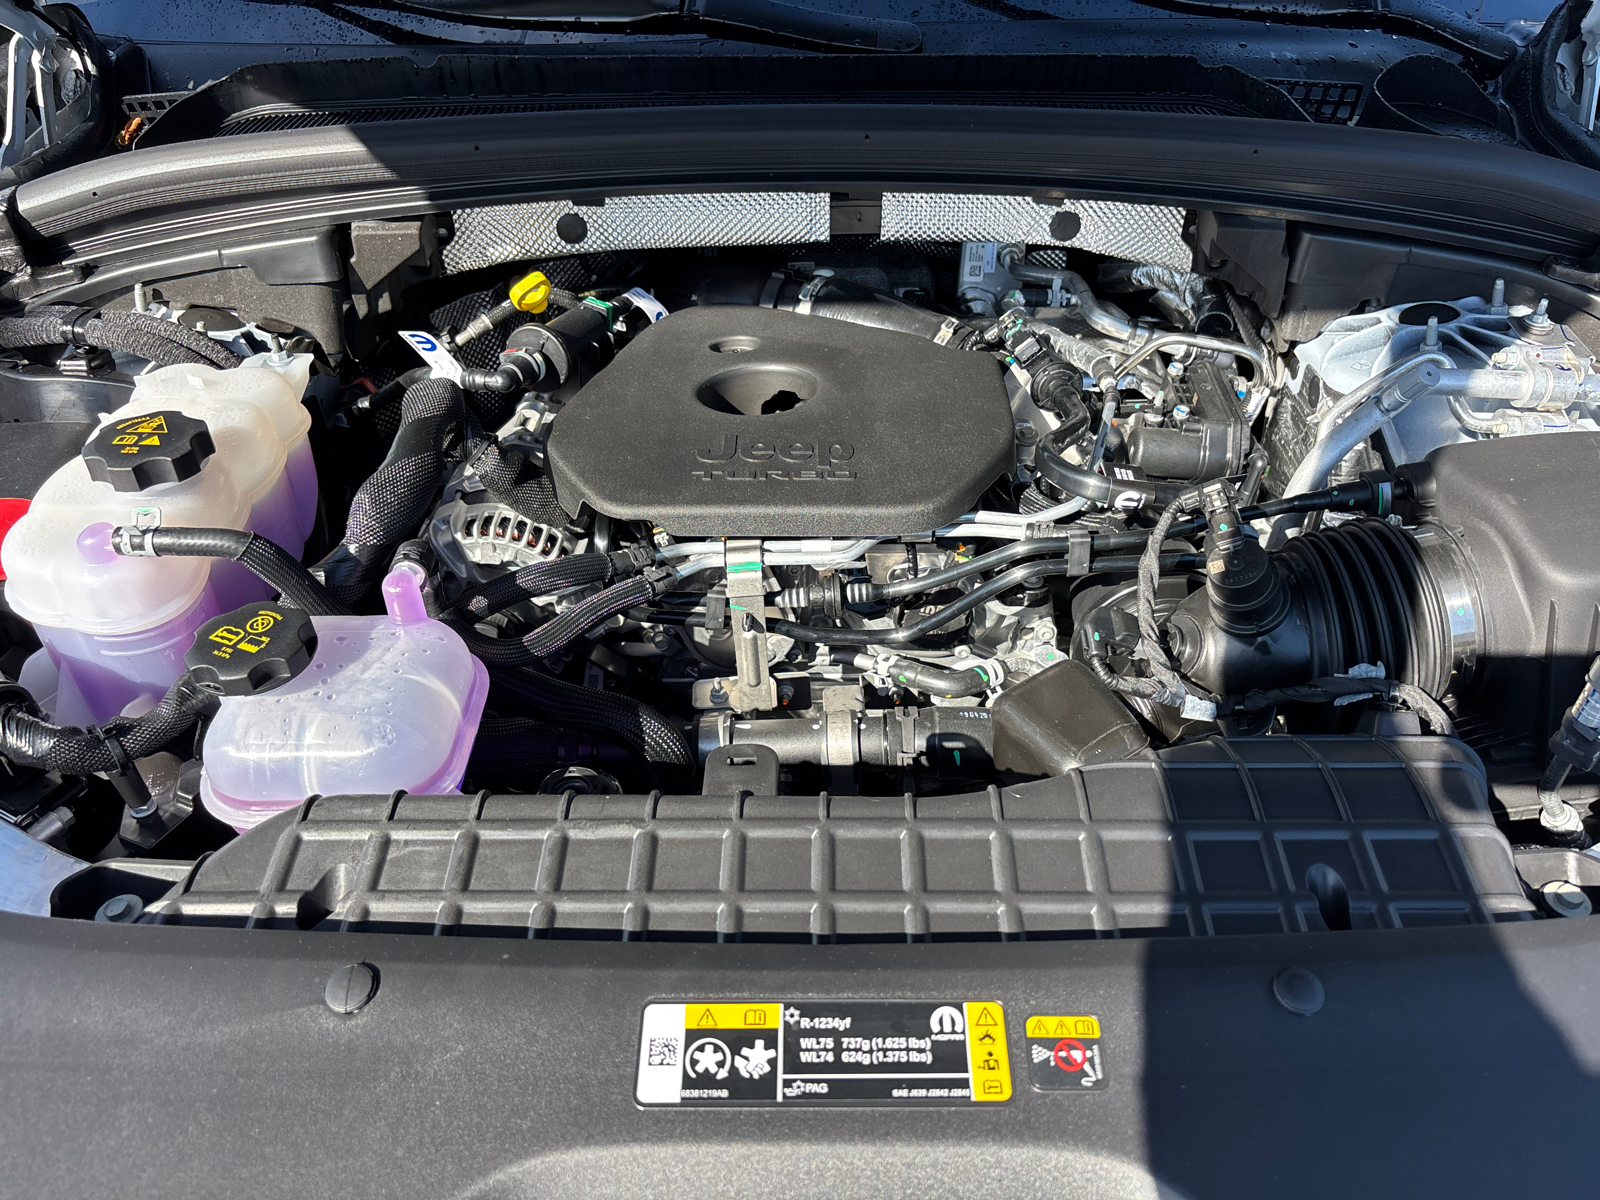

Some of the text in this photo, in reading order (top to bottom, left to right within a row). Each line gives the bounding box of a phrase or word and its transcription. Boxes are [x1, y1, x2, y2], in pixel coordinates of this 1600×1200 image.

[696, 434, 855, 468] Jeep
[691, 470, 857, 481] TURBO
[800, 1017, 851, 1031] R-1234yf
[800, 1037, 931, 1051] WL75 737g (1.625 lbs)
[800, 1051, 932, 1065] WL74 624g (1.375 lbs)
[805, 1082, 829, 1094] PAG
[891, 1088, 909, 1098] SAE
